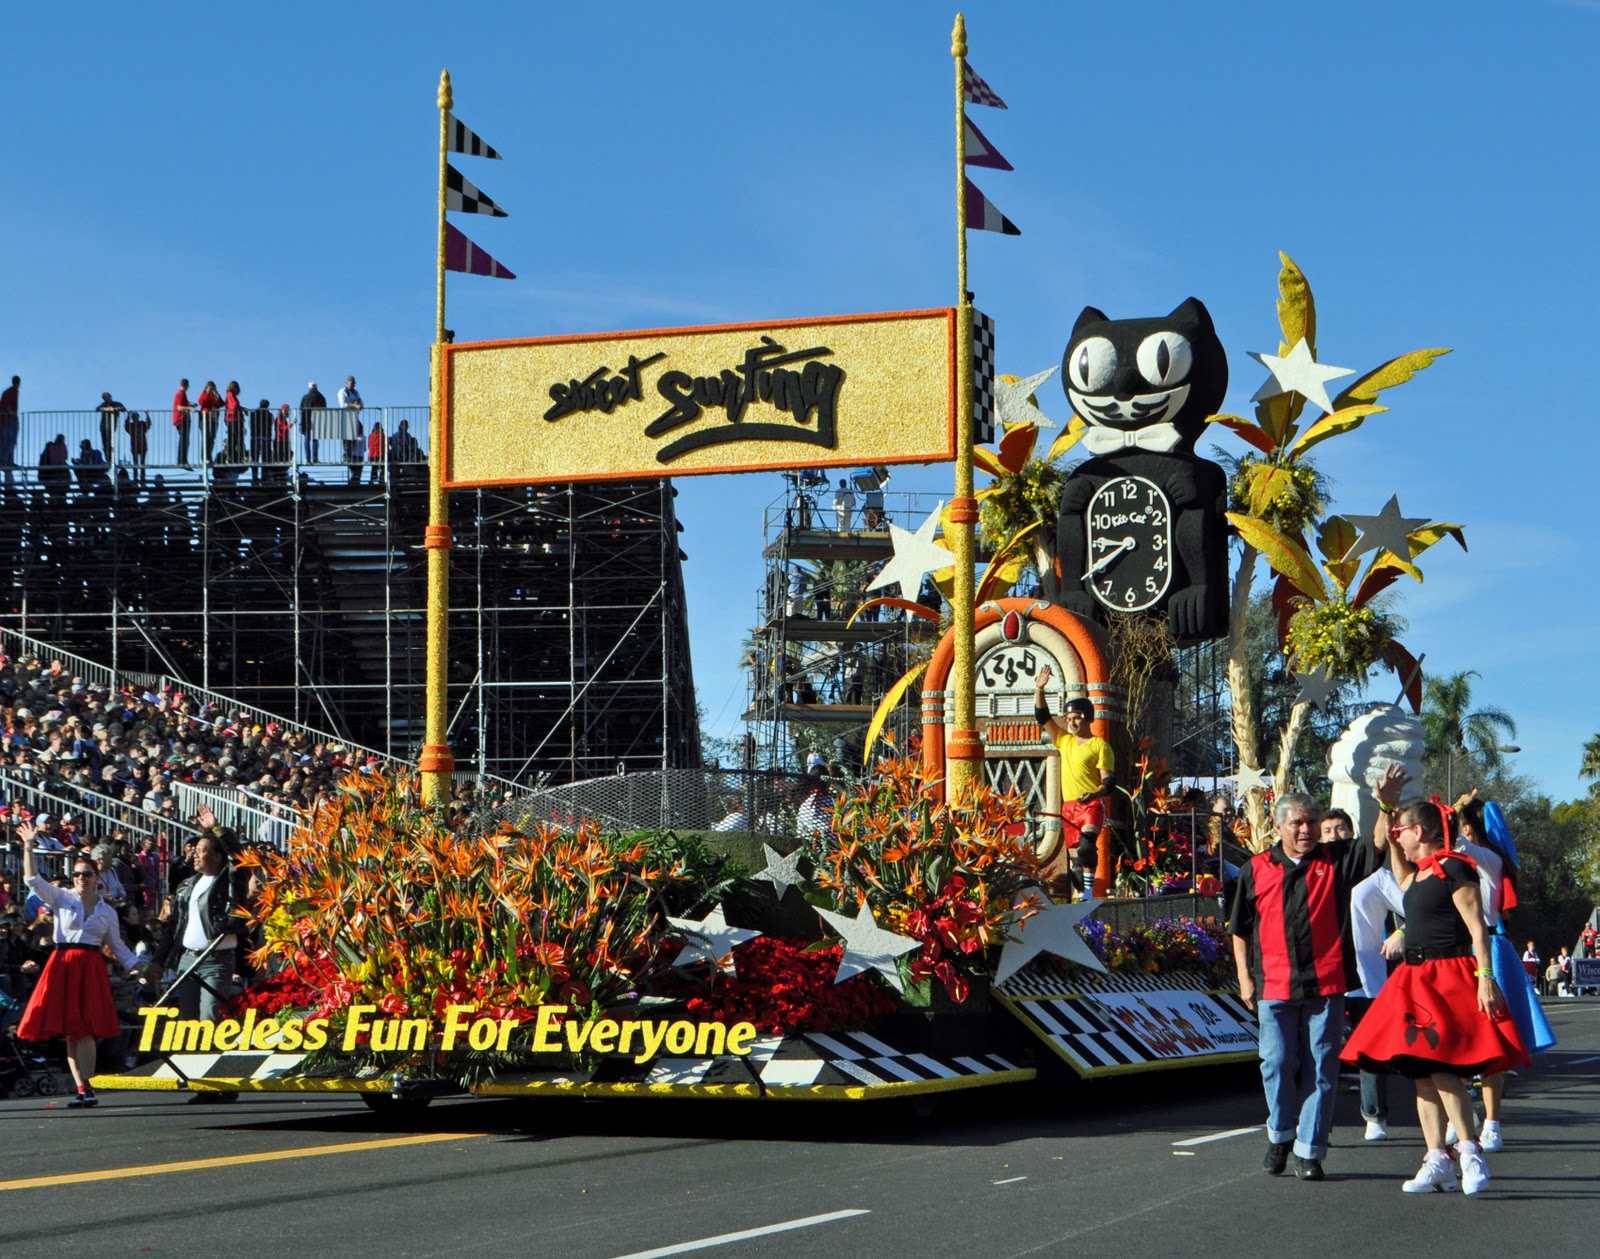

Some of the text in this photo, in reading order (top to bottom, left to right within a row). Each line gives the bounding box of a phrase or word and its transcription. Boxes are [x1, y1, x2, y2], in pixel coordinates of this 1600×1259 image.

[543, 336, 846, 463] Street Surfing
[1103, 491, 1115, 507] 11
[1120, 483, 1138, 500] 12
[1147, 489, 1154, 505] 1
[1094, 513, 1111, 530] 10
[1151, 510, 1163, 526] 2
[1152, 534, 1163, 551] 3
[1153, 556, 1164, 572] 4
[1103, 580, 1113, 596] 7
[1145, 576, 1157, 593] 5
[1124, 587, 1136, 603] 6
[138, 1004, 757, 1065] Timeless Fun For Everyone
